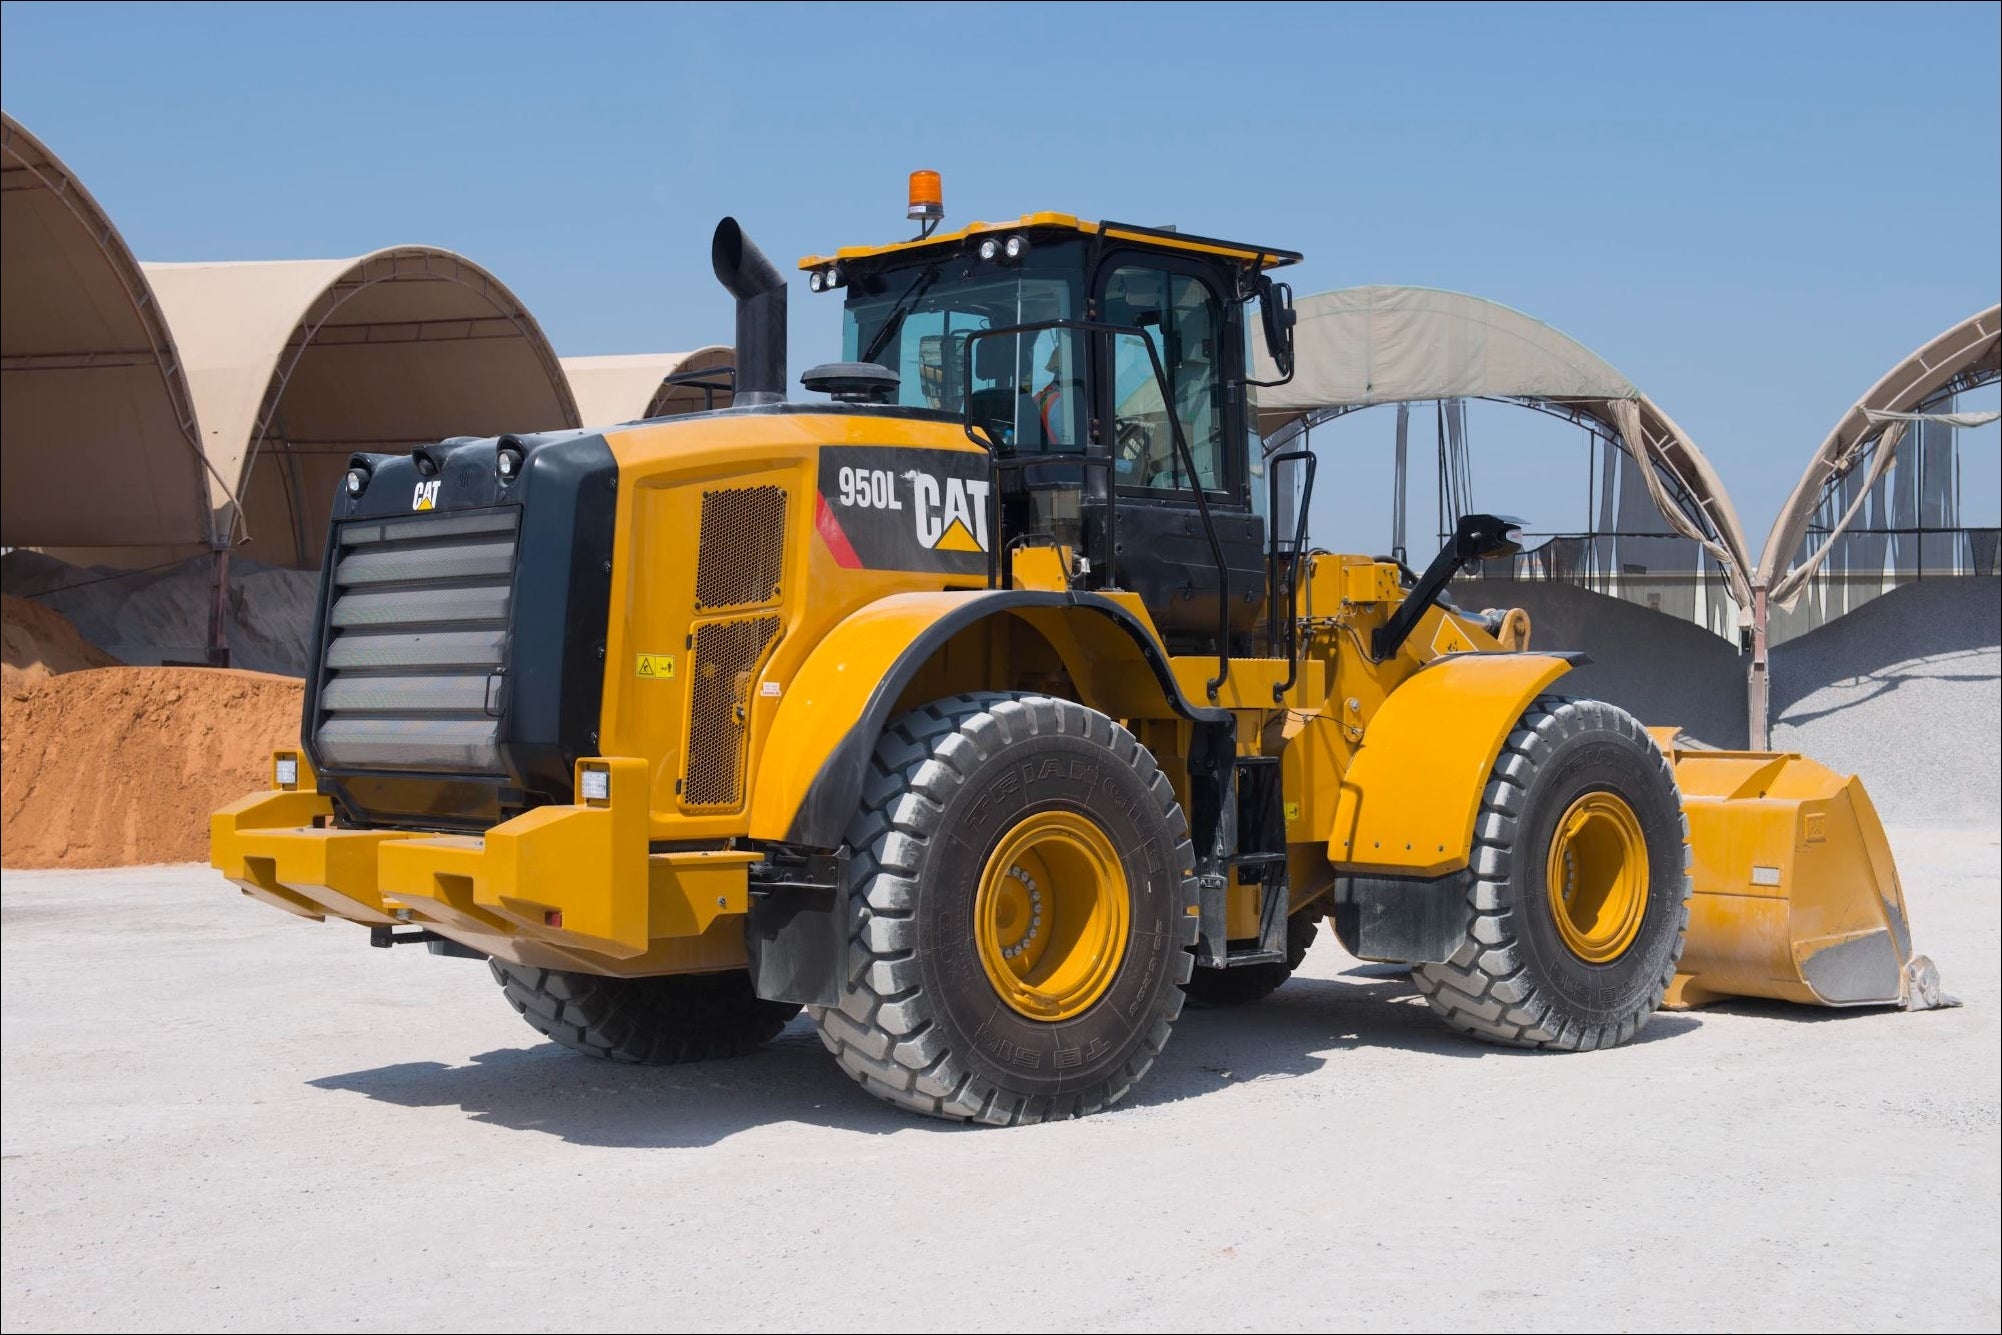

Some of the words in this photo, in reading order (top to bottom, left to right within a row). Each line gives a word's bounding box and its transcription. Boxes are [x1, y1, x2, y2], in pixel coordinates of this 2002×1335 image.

[413, 480, 441, 511] CAT
[839, 467, 902, 509] 950L
[914, 473, 989, 552] CAT
[964, 759, 1160, 873] TRIANGLE
